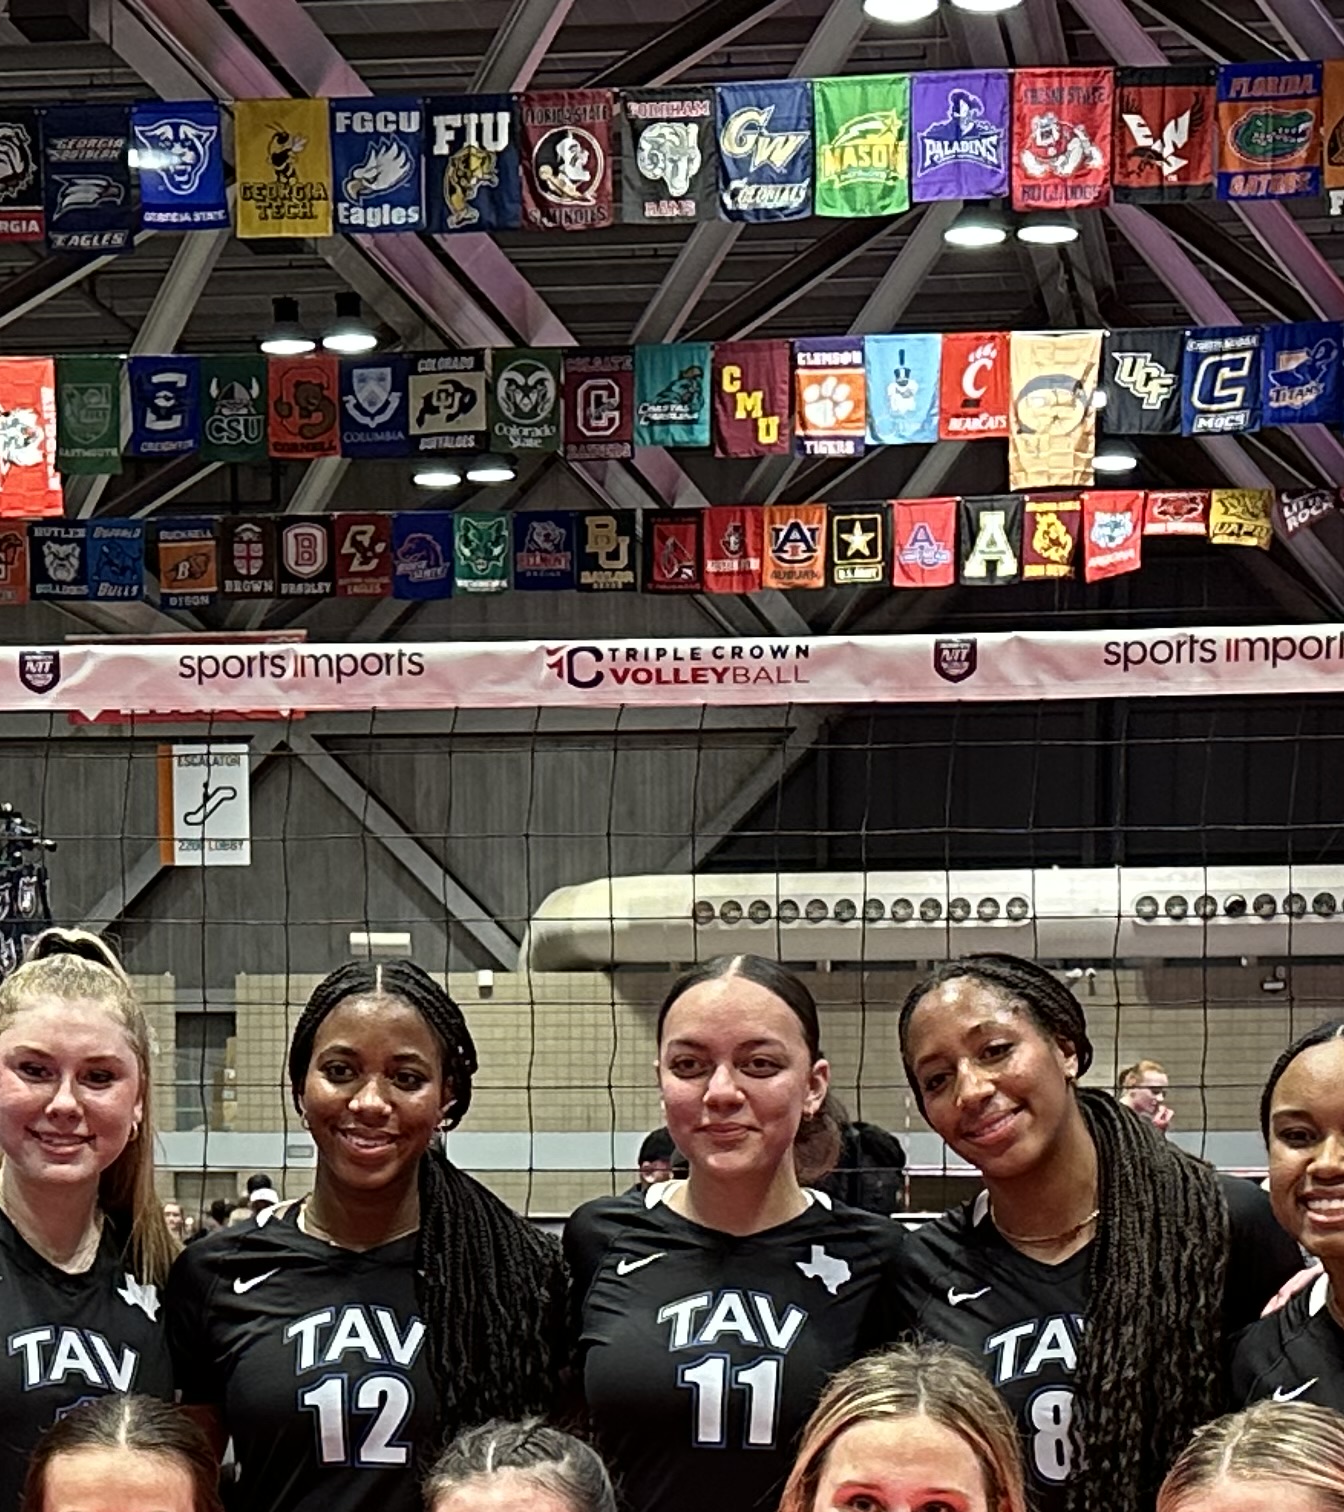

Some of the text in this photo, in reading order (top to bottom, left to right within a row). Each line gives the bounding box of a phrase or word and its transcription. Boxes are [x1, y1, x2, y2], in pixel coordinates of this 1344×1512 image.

[1230, 74, 1317, 96] FLORIDA
[335, 111, 420, 134] FGCU
[432, 111, 510, 155] FIU
[56, 137, 124, 151] GEORGIA
[923, 138, 998, 164] PALADINS
[824, 144, 904, 176] MASON
[240, 182, 327, 201] GEORGIA
[256, 202, 318, 221] TECH
[338, 203, 420, 227] Eagles
[55, 232, 125, 249] EAGLES
[797, 351, 862, 365] CLEMSON
[1112, 352, 1177, 409] UCF
[577, 379, 620, 436] C
[206, 415, 264, 444] CSU
[494, 423, 554, 438] Colorado
[948, 413, 1007, 431] BEARCATS
[344, 430, 405, 444] COLUMBIA
[508, 436, 543, 449] State
[805, 440, 854, 455] TIGERS
[294, 533, 317, 566] B
[964, 511, 1019, 577] A
[224, 581, 274, 592] BROWN
[609, 644, 810, 662] TRIPLE CROWN
[1103, 636, 1217, 672] sports
[178, 648, 424, 685] sports imports
[609, 665, 810, 685] VOLLEYBALL
[658, 1289, 808, 1352] TAV
[284, 1306, 426, 1373] TAV
[984, 1314, 1086, 1386] TA
[8, 1328, 138, 1394] TAV
[680, 1355, 783, 1449] 11
[301, 1375, 413, 1466] 12
[1027, 1386, 1086, 1486] 8
